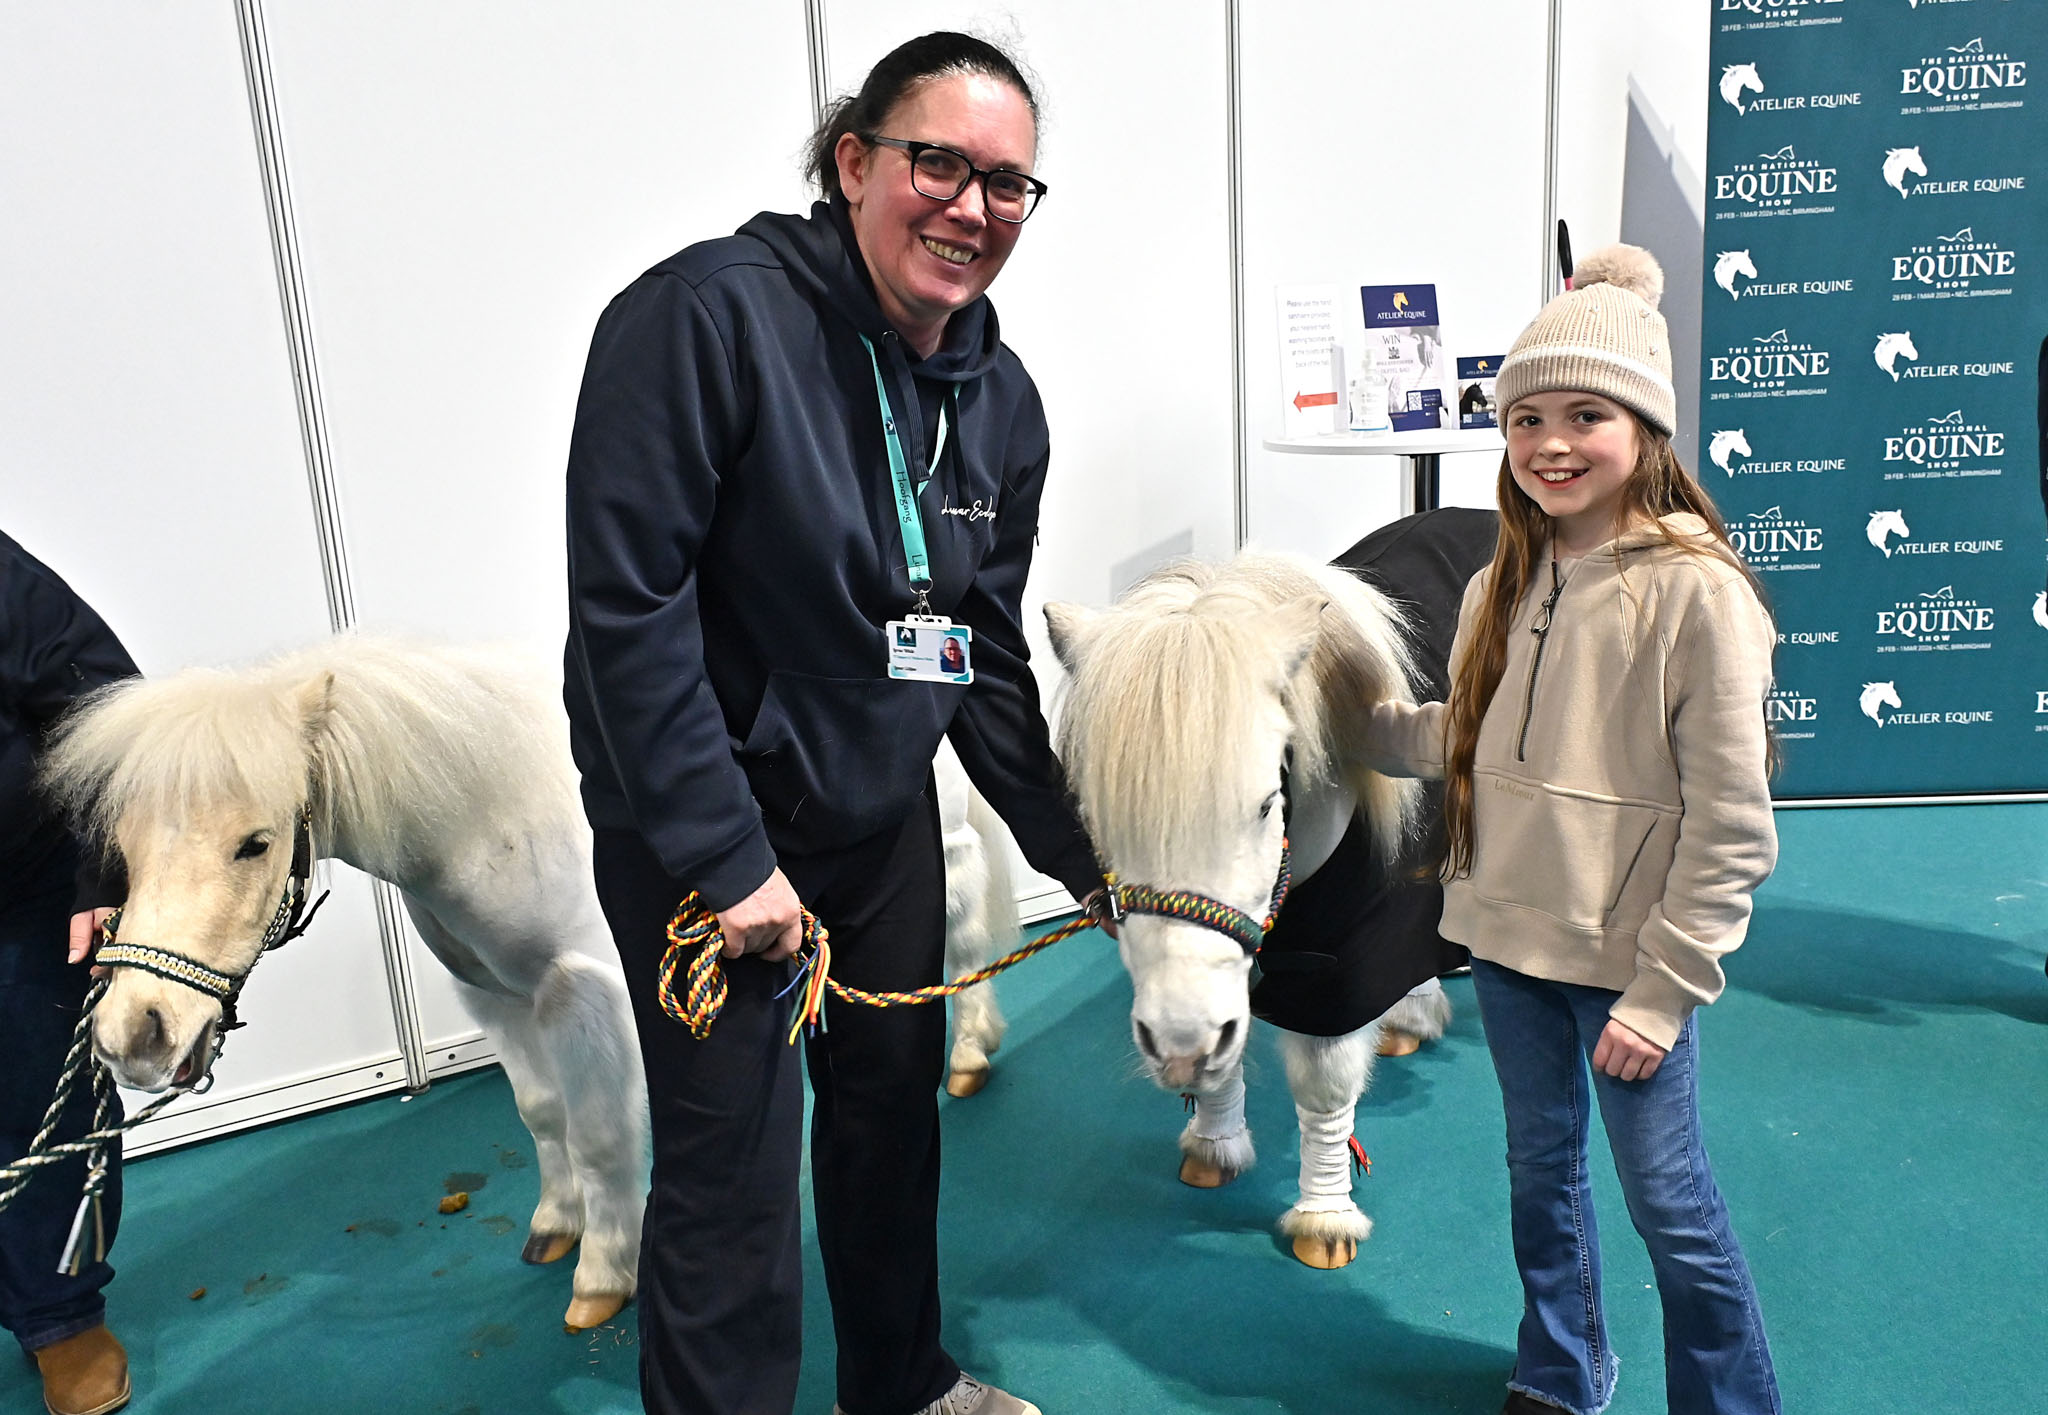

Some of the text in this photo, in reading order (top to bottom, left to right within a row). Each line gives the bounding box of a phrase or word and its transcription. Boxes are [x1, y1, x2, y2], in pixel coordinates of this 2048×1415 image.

[1765, 9, 1799, 18] SHOW
[1921, 53, 2008, 65] THE NATIONAL
[1900, 61, 2026, 97] EQUINE
[1749, 93, 1861, 111] ATELIER EQUINE
[1946, 93, 1980, 102] SHOW
[1734, 160, 1819, 172] THE NATIONAL
[1715, 168, 1837, 202] EQUINE
[1912, 177, 2025, 195] ATELIER EQUINE
[1759, 199, 1792, 207] SHOW
[1912, 242, 1997, 254] THE NATIONAL
[1891, 251, 2015, 284] EQUINE
[1743, 279, 1853, 296] ATELIER EQUINE
[1936, 280, 1969, 289] SHOW
[1377, 310, 1426, 320] ATELIER EQUINE
[1382, 334, 1401, 345] WIN
[1755, 344, 1812, 353] NATIONAL
[1709, 352, 1830, 384] EQUINE
[1903, 362, 2014, 378] ATELIER EQUINE
[1753, 380, 1785, 388] SHOW
[1903, 425, 1987, 435] THE NATIONAL
[1883, 433, 2004, 464] EQUINE
[1738, 459, 1845, 474] ATELIER EQUINE
[1927, 461, 1959, 469] SHOW
[896, 471, 912, 524] Hoofgang
[941, 494, 970, 516] Lunar
[1750, 520, 1805, 528] NATIONAL
[1727, 529, 1823, 557] QUINE
[1895, 540, 2003, 554] ATELIER EQUINE
[1748, 555, 1779, 563] SHOW
[1921, 600, 1977, 608] NATIONAL
[1876, 608, 1994, 637] EQUINE
[1791, 632, 1839, 645] EQUINE
[1765, 698, 1818, 721] INE
[1887, 711, 1993, 724] ATELIER EQUINE
